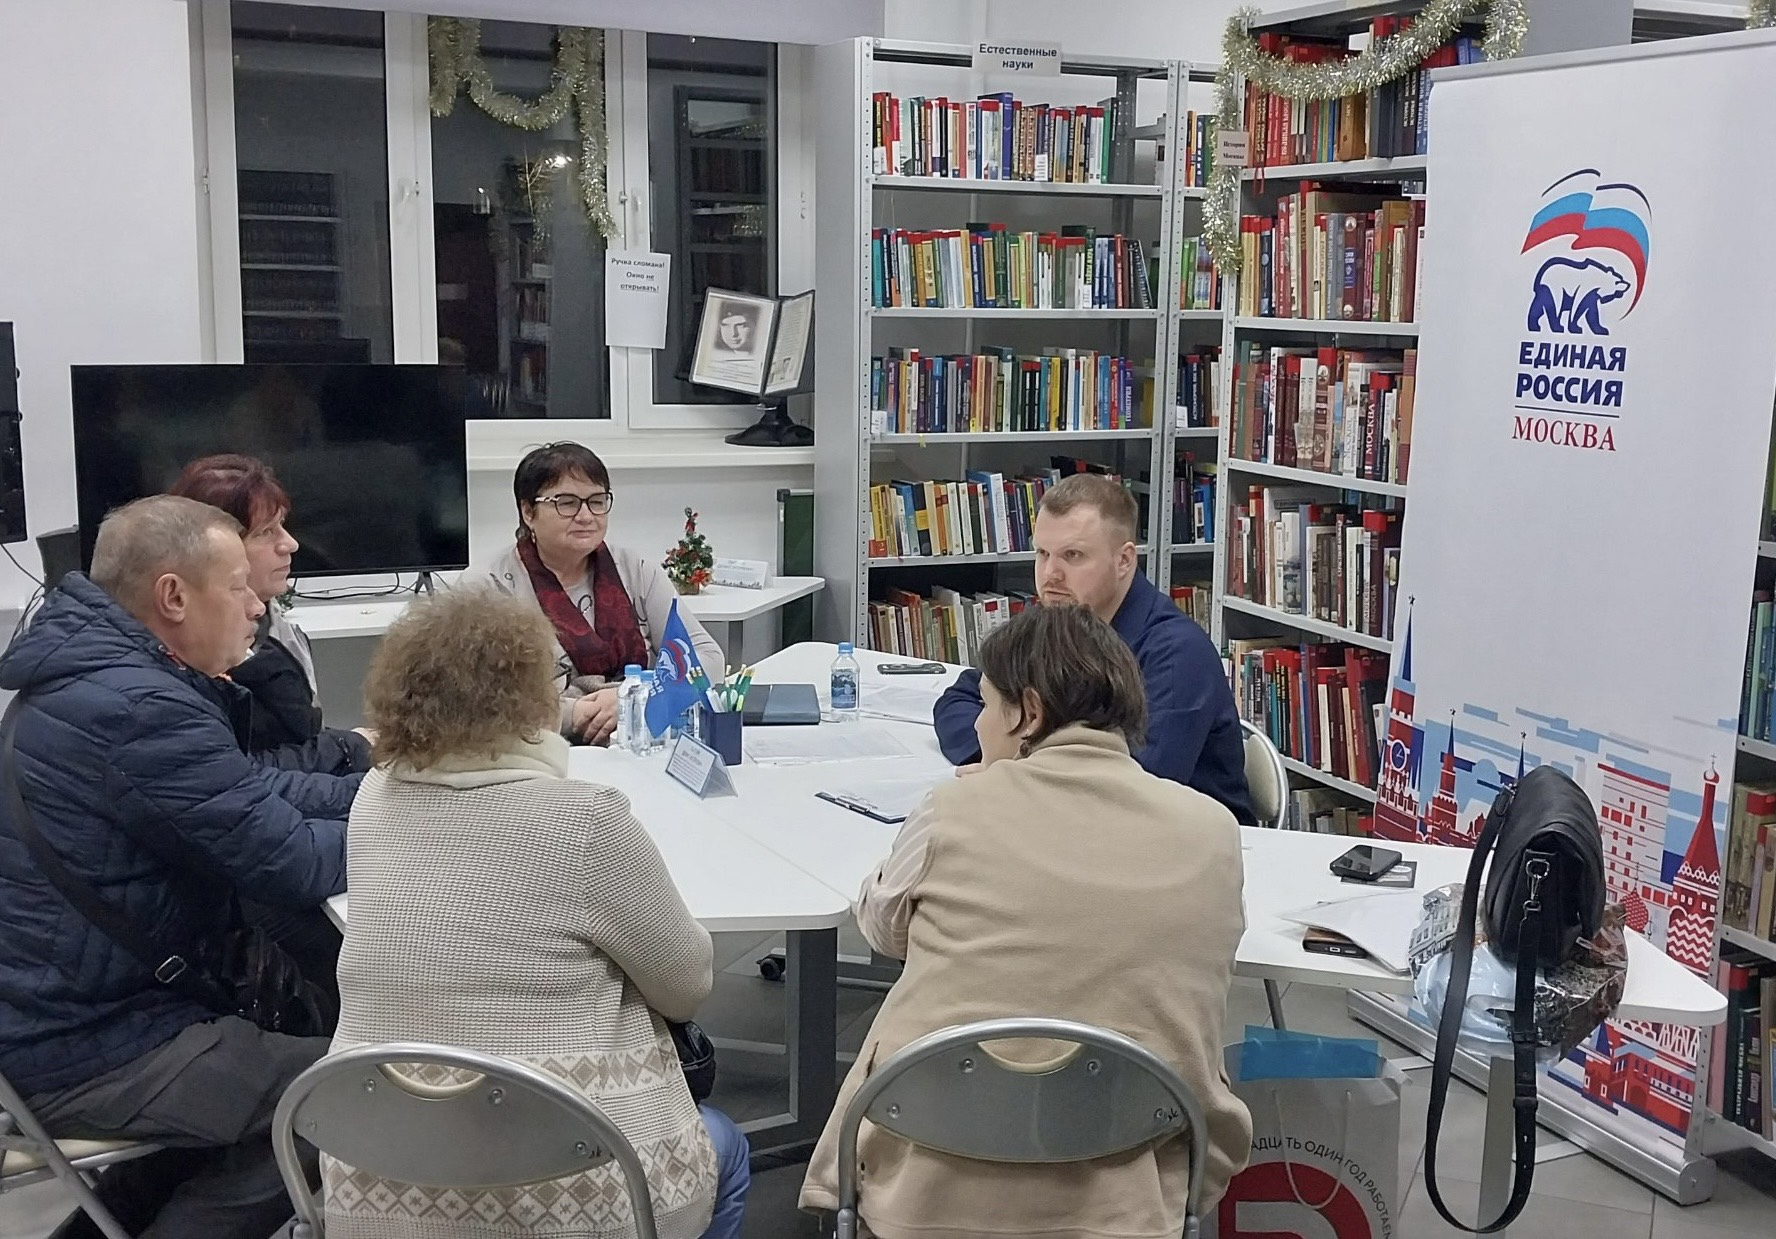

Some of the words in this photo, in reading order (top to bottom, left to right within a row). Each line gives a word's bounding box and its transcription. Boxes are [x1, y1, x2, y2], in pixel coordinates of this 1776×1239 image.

[979, 43, 1057, 57] Естественные
[1002, 60, 1034, 71] науки
[611, 258, 632, 266] Ручка
[633, 260, 665, 268] сломана!
[626, 271, 645, 279] Окно
[620, 283, 660, 293] открывать!
[1519, 341, 1627, 372] ЕДИНАЯ
[1516, 372, 1623, 407] РОССИЯ
[1365, 403, 1375, 455] МОСКВА
[1512, 415, 1617, 451] МОСКВА
[1304, 1140, 1344, 1166] ОДИН
[1345, 1159, 1367, 1184] ГОД
